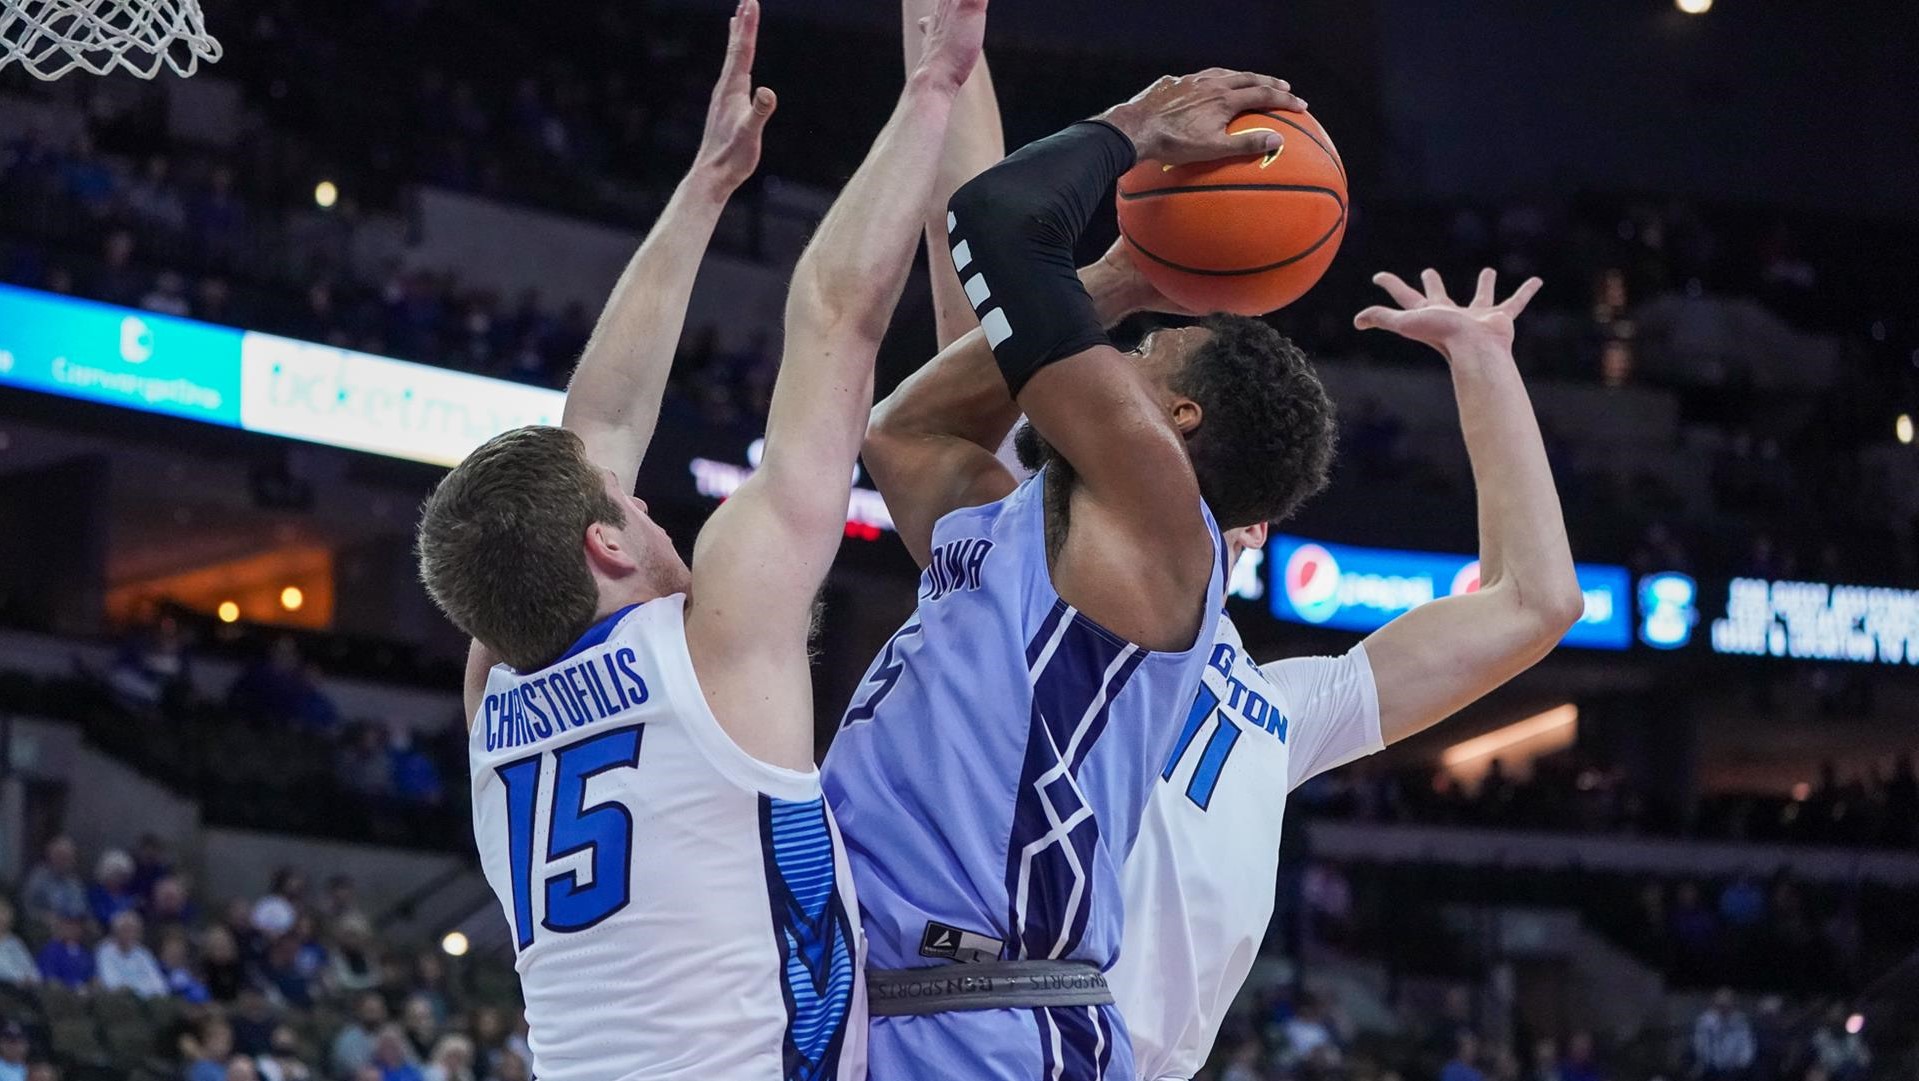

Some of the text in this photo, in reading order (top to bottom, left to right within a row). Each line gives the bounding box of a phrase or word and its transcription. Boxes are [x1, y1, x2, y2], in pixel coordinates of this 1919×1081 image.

[484, 647, 649, 752] CHRISTOFILIS
[1161, 679, 1243, 813] 11
[493, 722, 646, 953] 15
